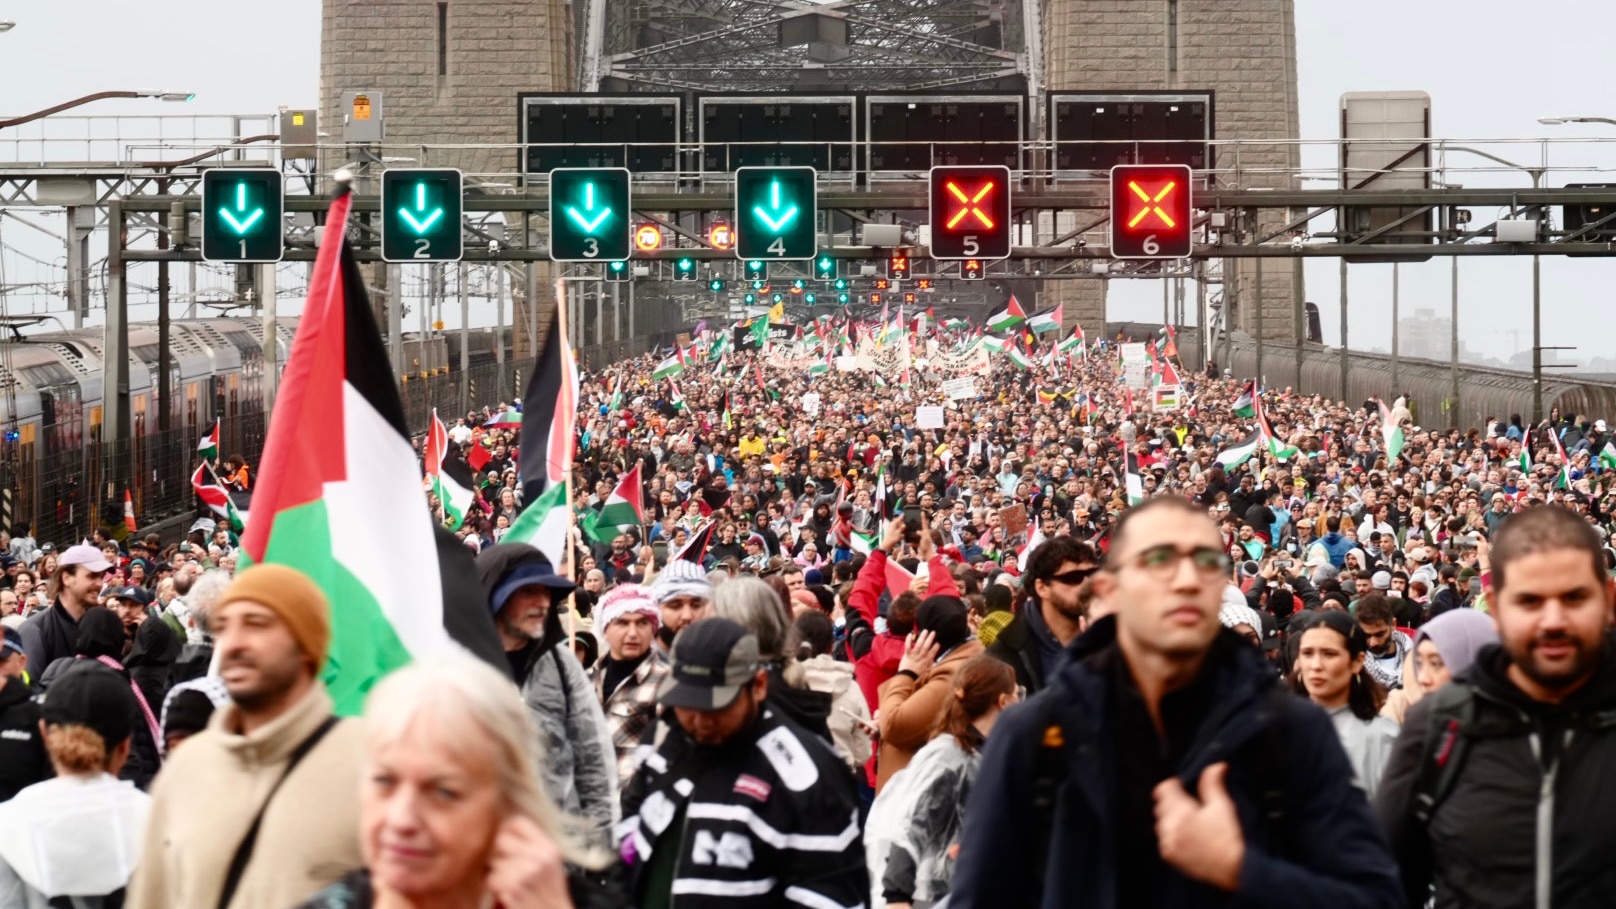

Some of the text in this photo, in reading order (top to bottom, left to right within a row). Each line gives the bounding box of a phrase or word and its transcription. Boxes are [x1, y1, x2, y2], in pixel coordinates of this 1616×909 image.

[641, 231, 656, 244] 70
[962, 235, 980, 256] 5
[1142, 233, 1160, 255] 6
[238, 238, 246, 259] 1
[413, 238, 431, 259] 2
[582, 237, 599, 258] 3
[766, 236, 786, 257] 4
[681, 272, 690, 281] 2
[752, 271, 760, 280] 3
[820, 271, 830, 280] 4
[894, 270, 903, 279] 5
[967, 270, 977, 279] 6
